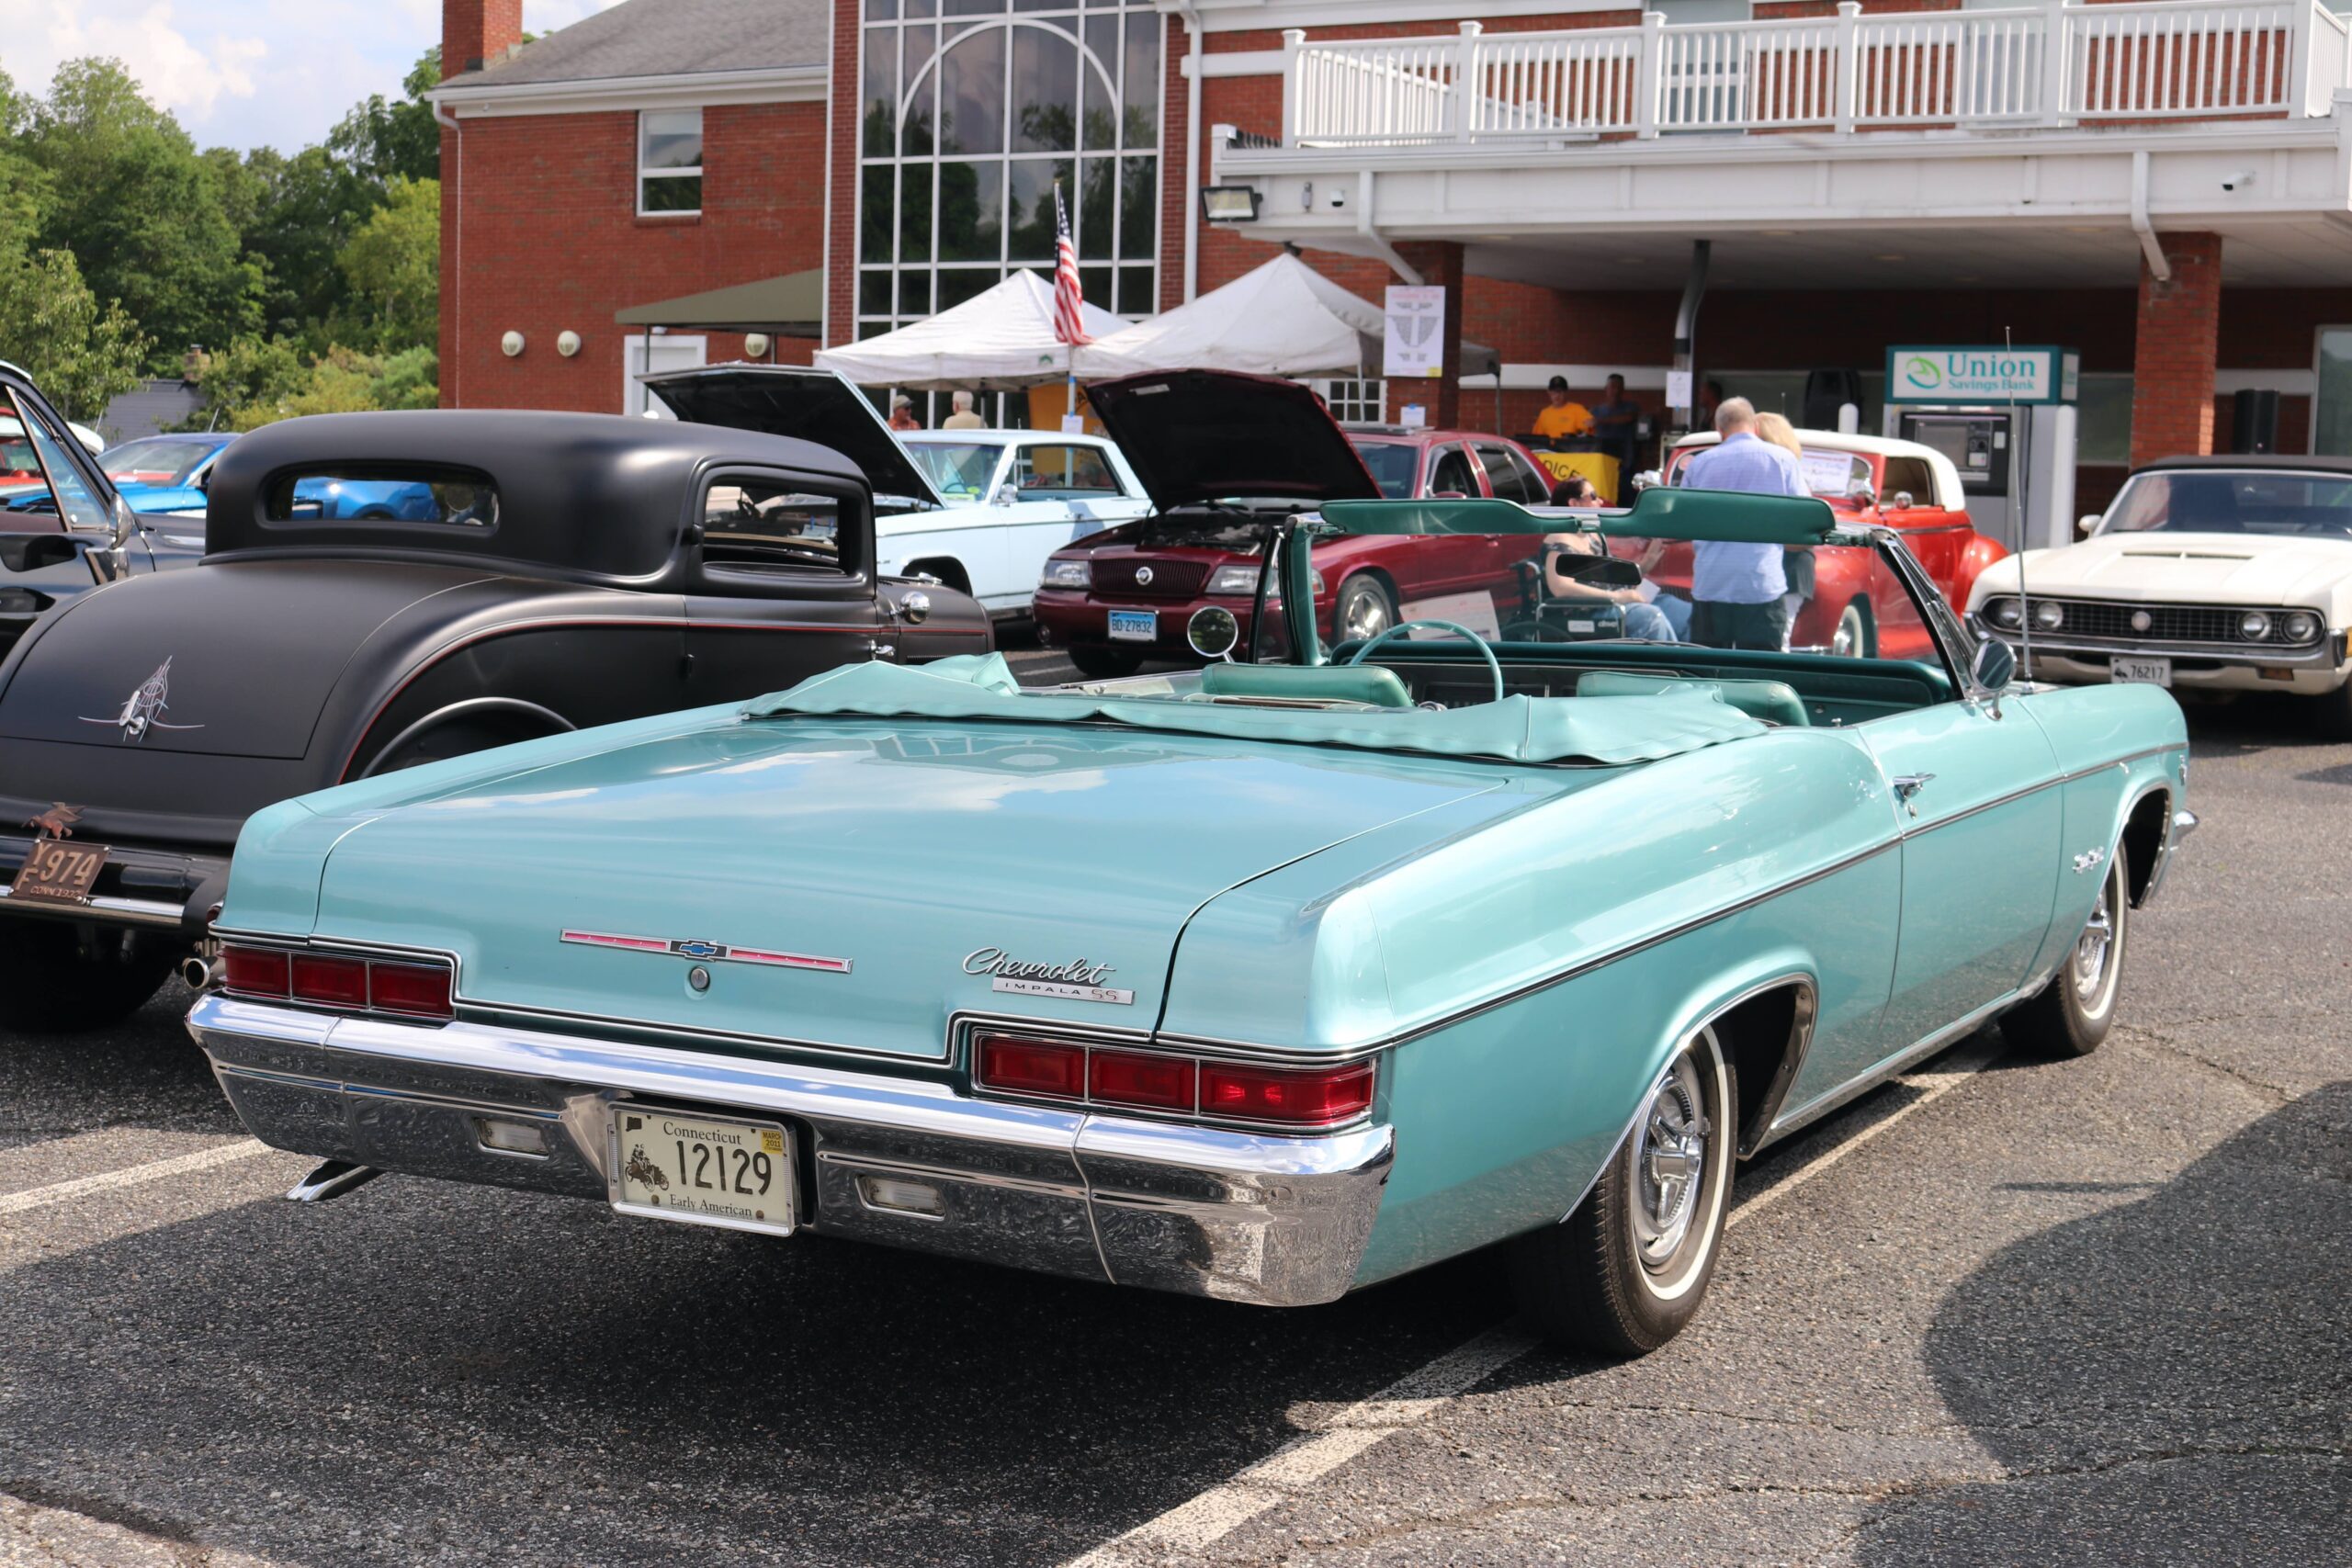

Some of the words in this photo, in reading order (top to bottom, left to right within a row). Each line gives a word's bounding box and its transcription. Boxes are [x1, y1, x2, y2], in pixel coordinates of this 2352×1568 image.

[1948, 354, 2036, 378] Union
[1949, 379, 1998, 392] Savings
[2002, 379, 2035, 390] Bank
[2131, 664, 2164, 679] 76217
[40, 850, 98, 886] 974
[963, 947, 1116, 985] Chevrolet
[1005, 982, 1080, 996] IMPALA
[1091, 988, 1117, 1001] SS
[663, 1122, 741, 1145] Connecticut
[765, 1139, 781, 1148] 2011
[676, 1141, 772, 1196] 12129
[670, 1194, 696, 1212] Early
[699, 1199, 752, 1217] American
